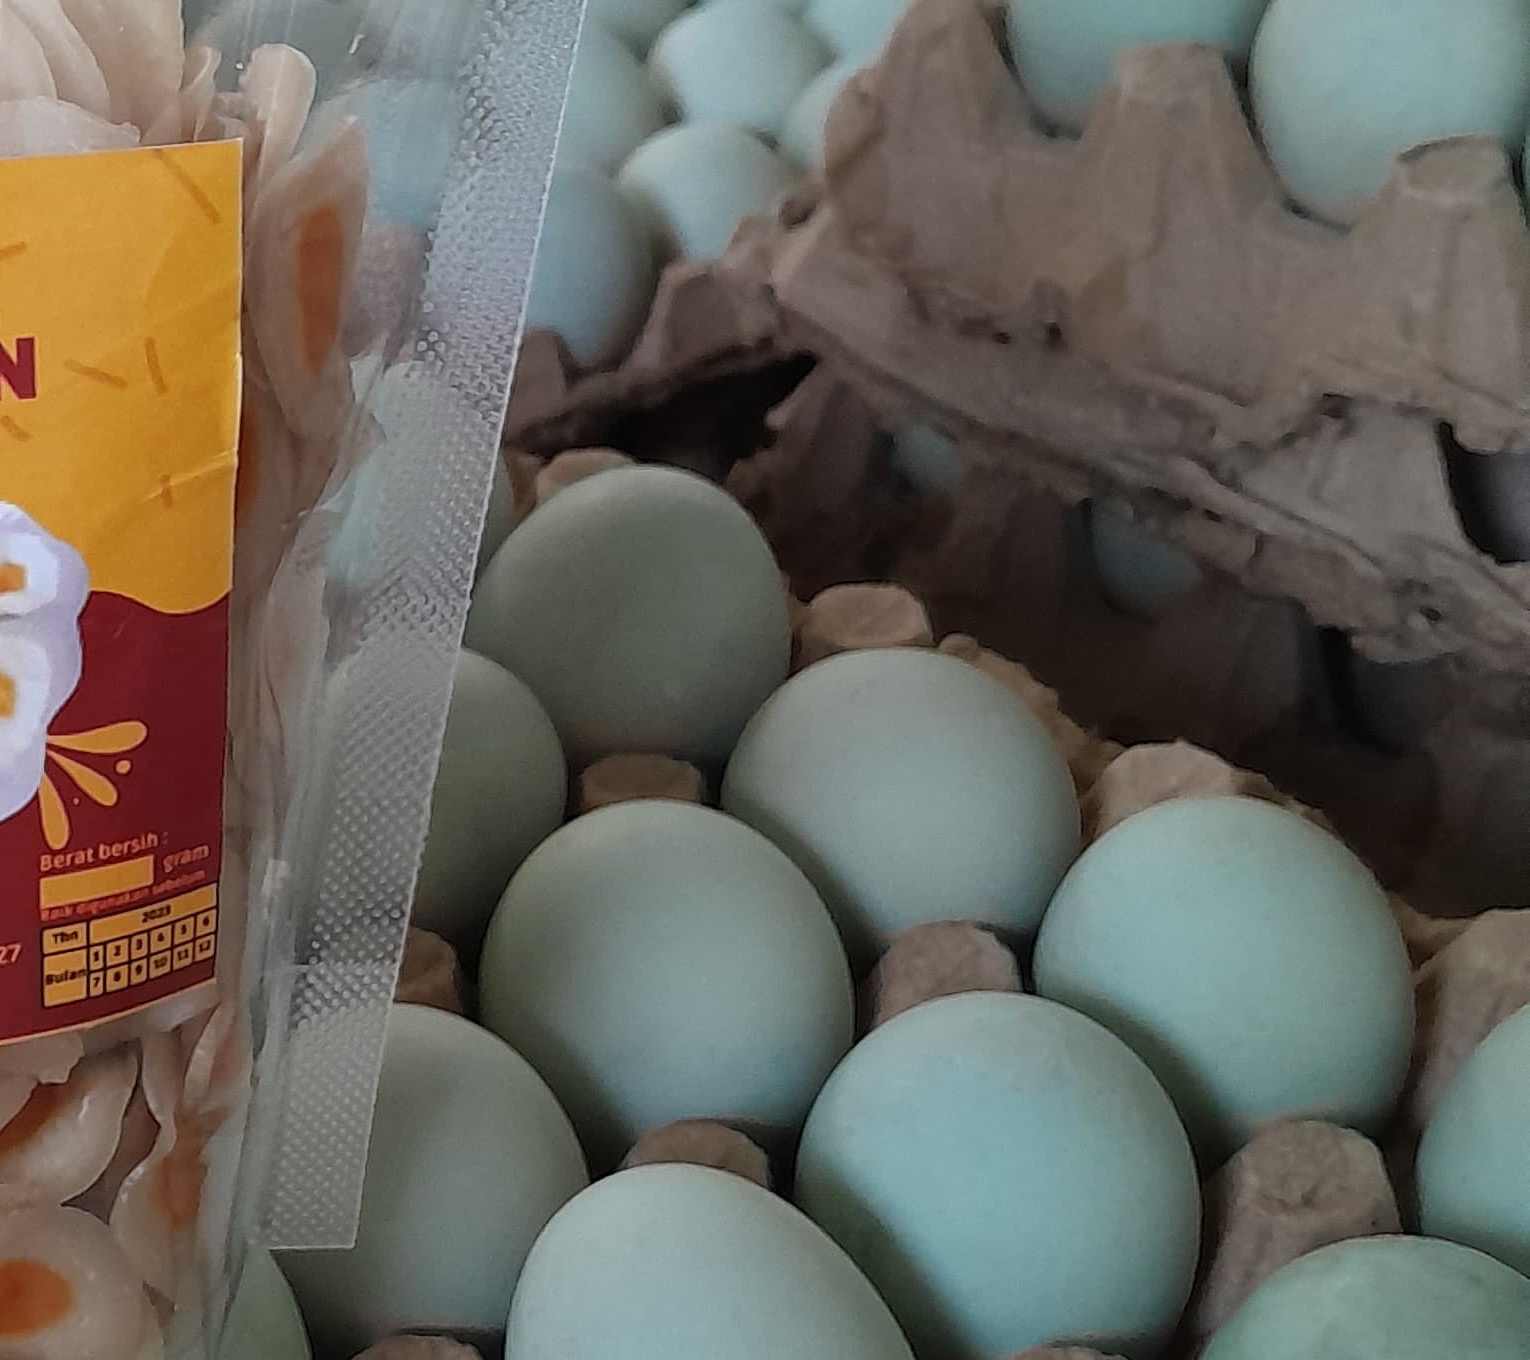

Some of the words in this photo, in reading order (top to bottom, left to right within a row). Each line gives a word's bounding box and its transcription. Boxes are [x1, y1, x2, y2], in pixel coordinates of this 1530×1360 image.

[40, 847, 95, 872] Berat
[98, 832, 159, 860] bersih
[162, 844, 210, 874] gram
